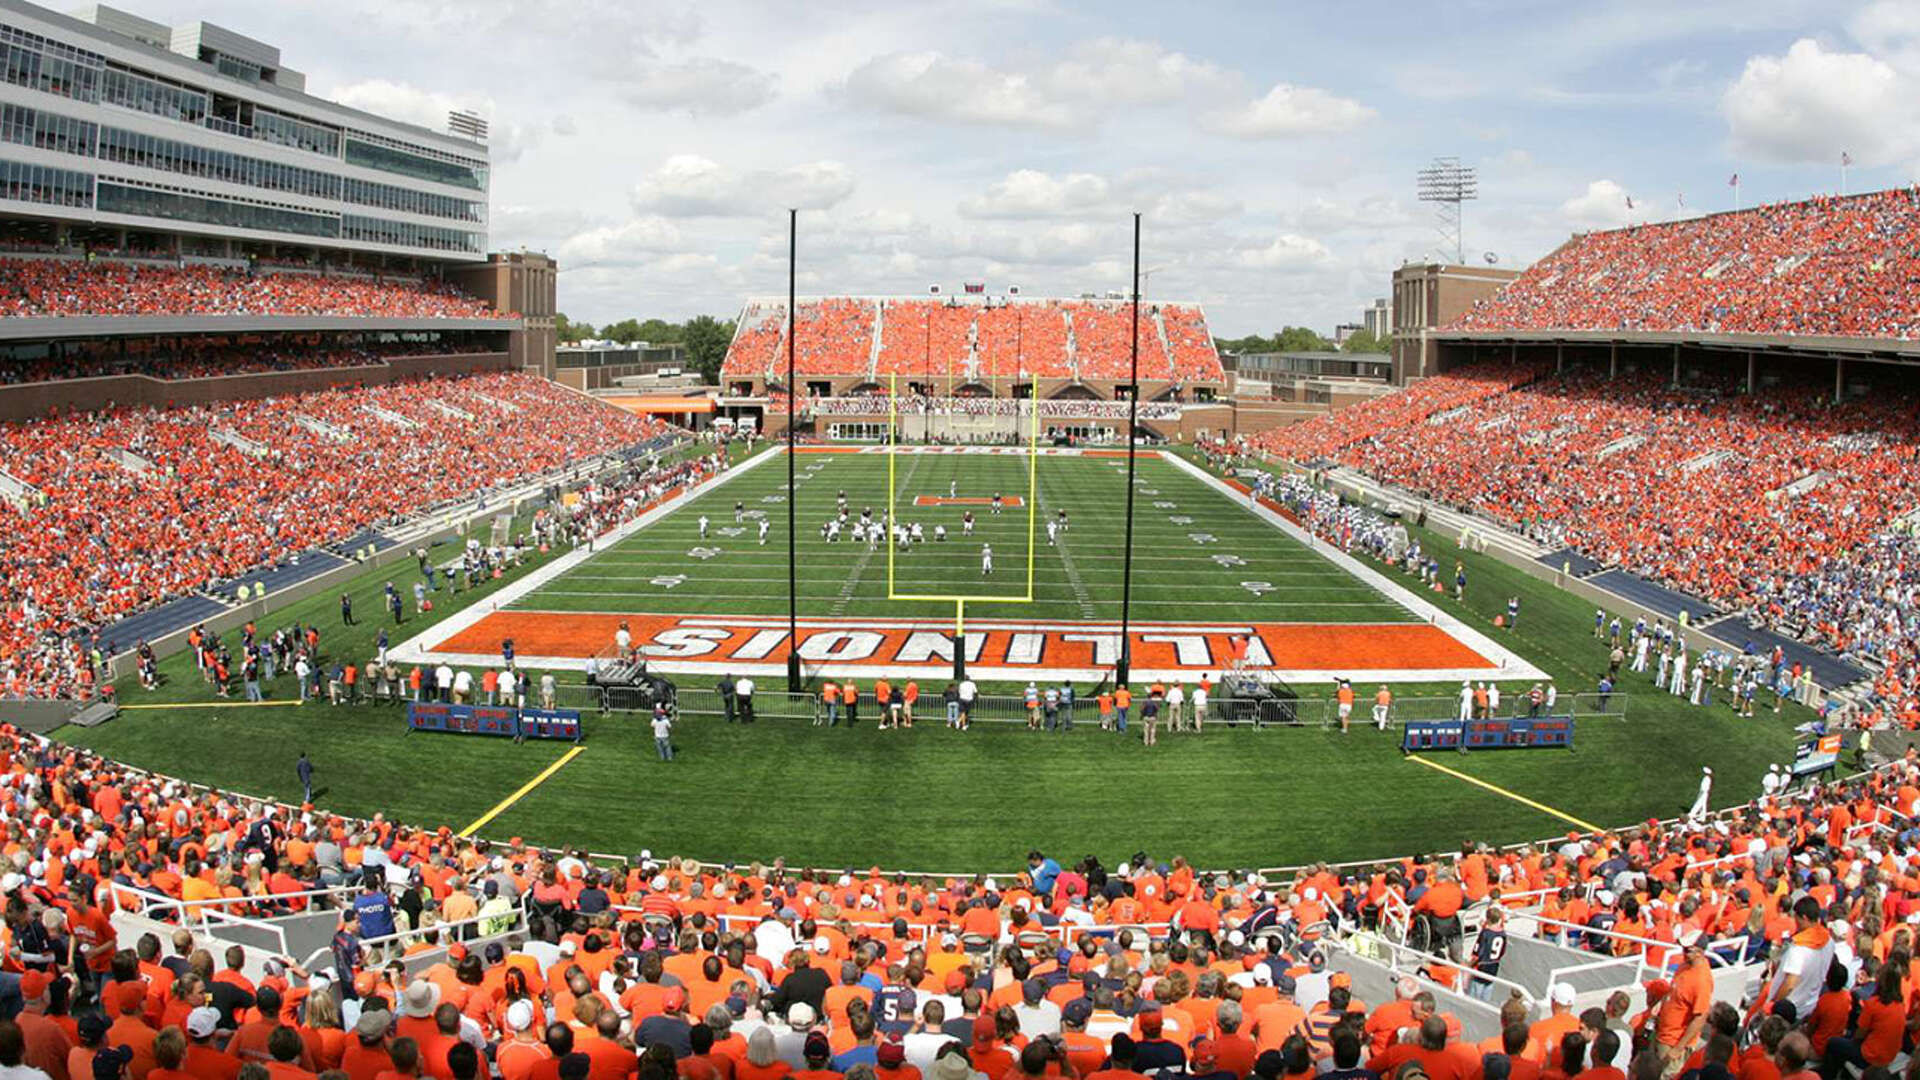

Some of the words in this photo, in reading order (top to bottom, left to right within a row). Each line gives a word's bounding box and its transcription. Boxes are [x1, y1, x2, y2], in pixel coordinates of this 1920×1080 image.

[637, 626, 1276, 666] ILLINOIS
[1490, 936, 1504, 960] 9
[884, 998, 898, 1021] 5
